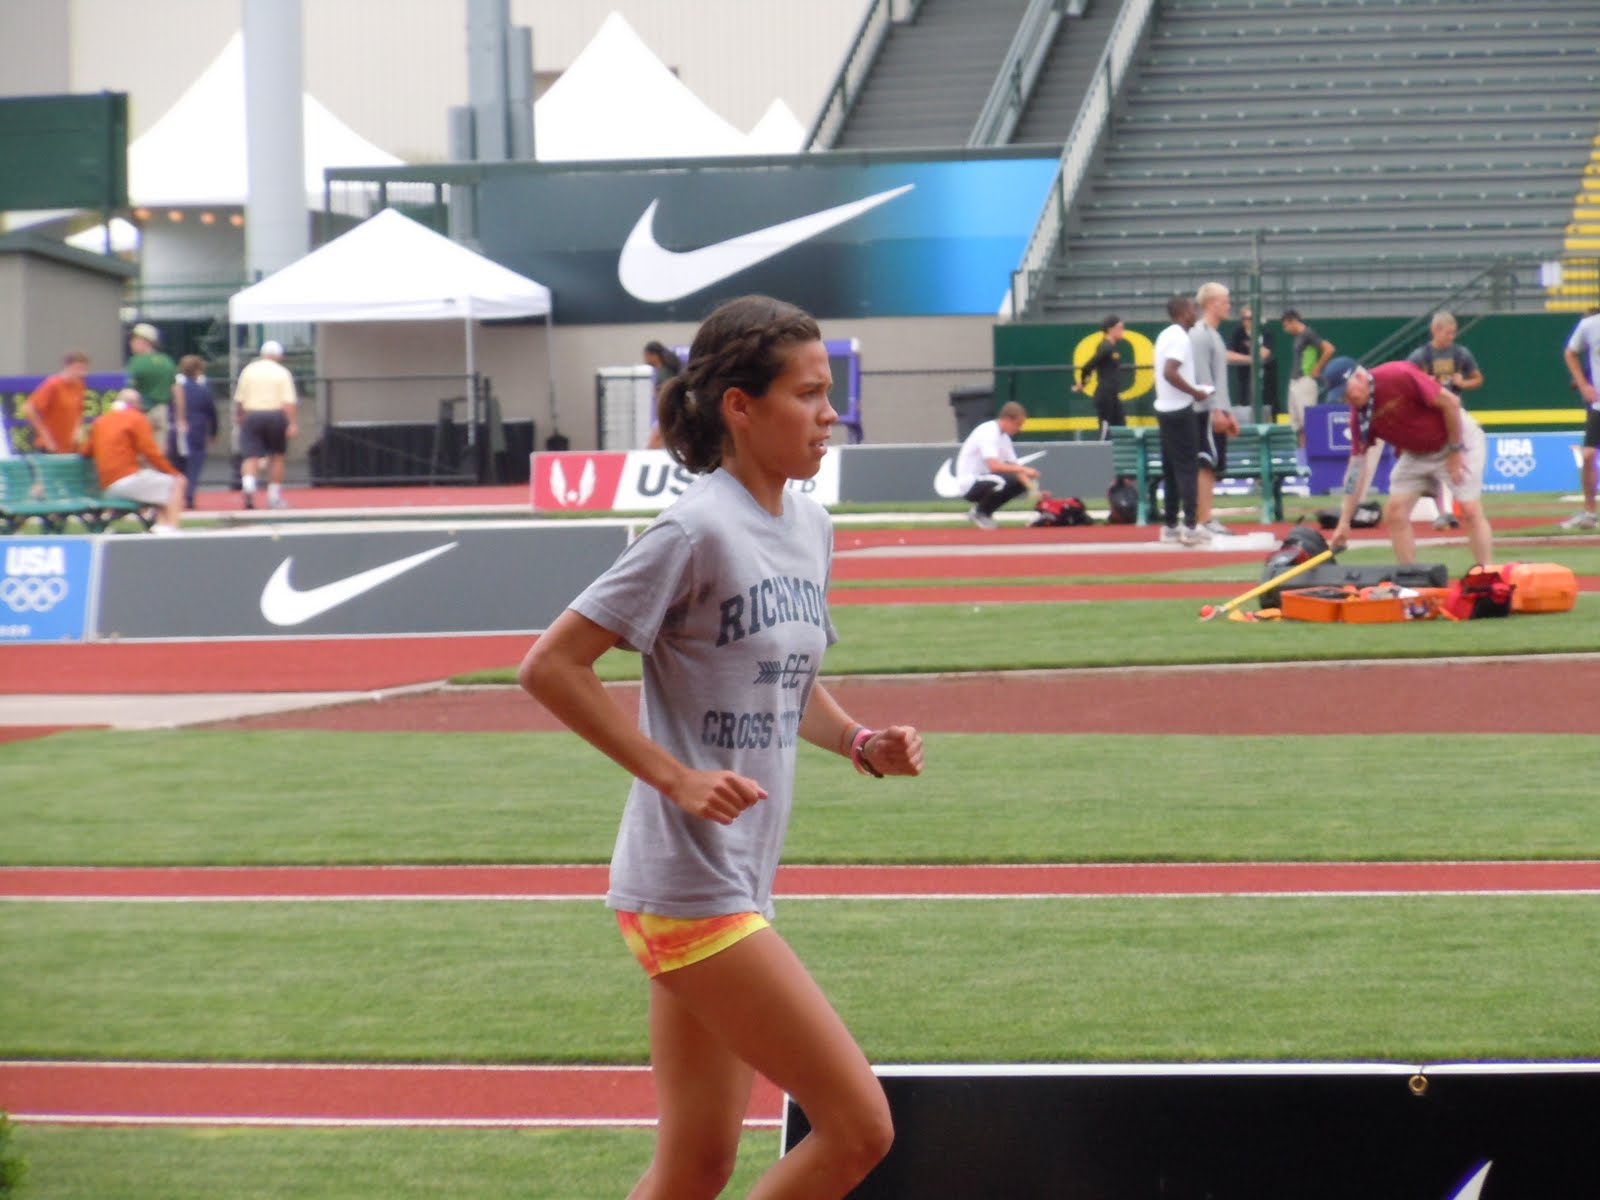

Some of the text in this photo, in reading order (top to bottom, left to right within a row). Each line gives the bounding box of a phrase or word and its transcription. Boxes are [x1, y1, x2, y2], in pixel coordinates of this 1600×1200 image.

[1496, 438, 1532, 456] USA
[6, 546, 65, 576] USA
[701, 710, 776, 750] CROSS
